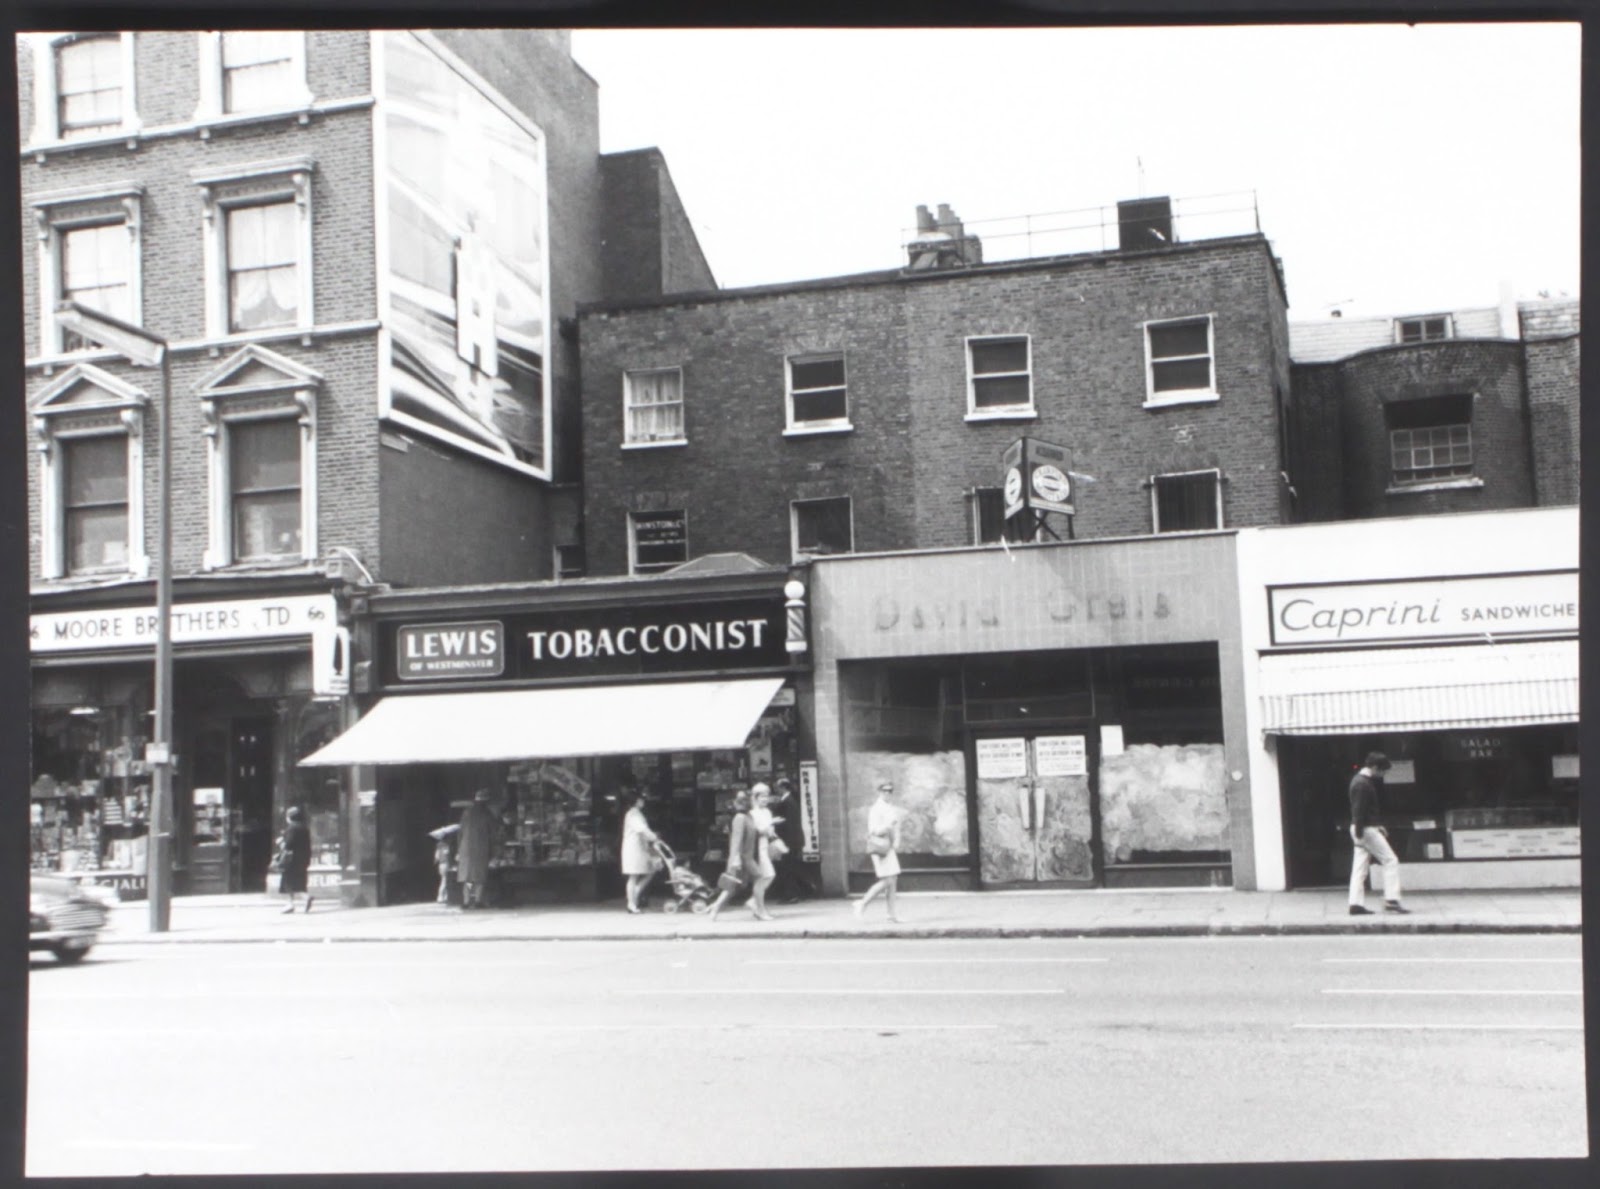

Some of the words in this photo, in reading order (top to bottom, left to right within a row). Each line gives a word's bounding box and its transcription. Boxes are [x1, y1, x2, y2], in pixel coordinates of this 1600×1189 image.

[54, 618, 122, 639] MOORE
[135, 609, 240, 635] BRTHERS
[1280, 598, 1441, 637] Caprini
[1461, 603, 1577, 622] SANDWICHE
[407, 629, 497, 658] LEWIS
[528, 619, 768, 659] TOBACCONIST
